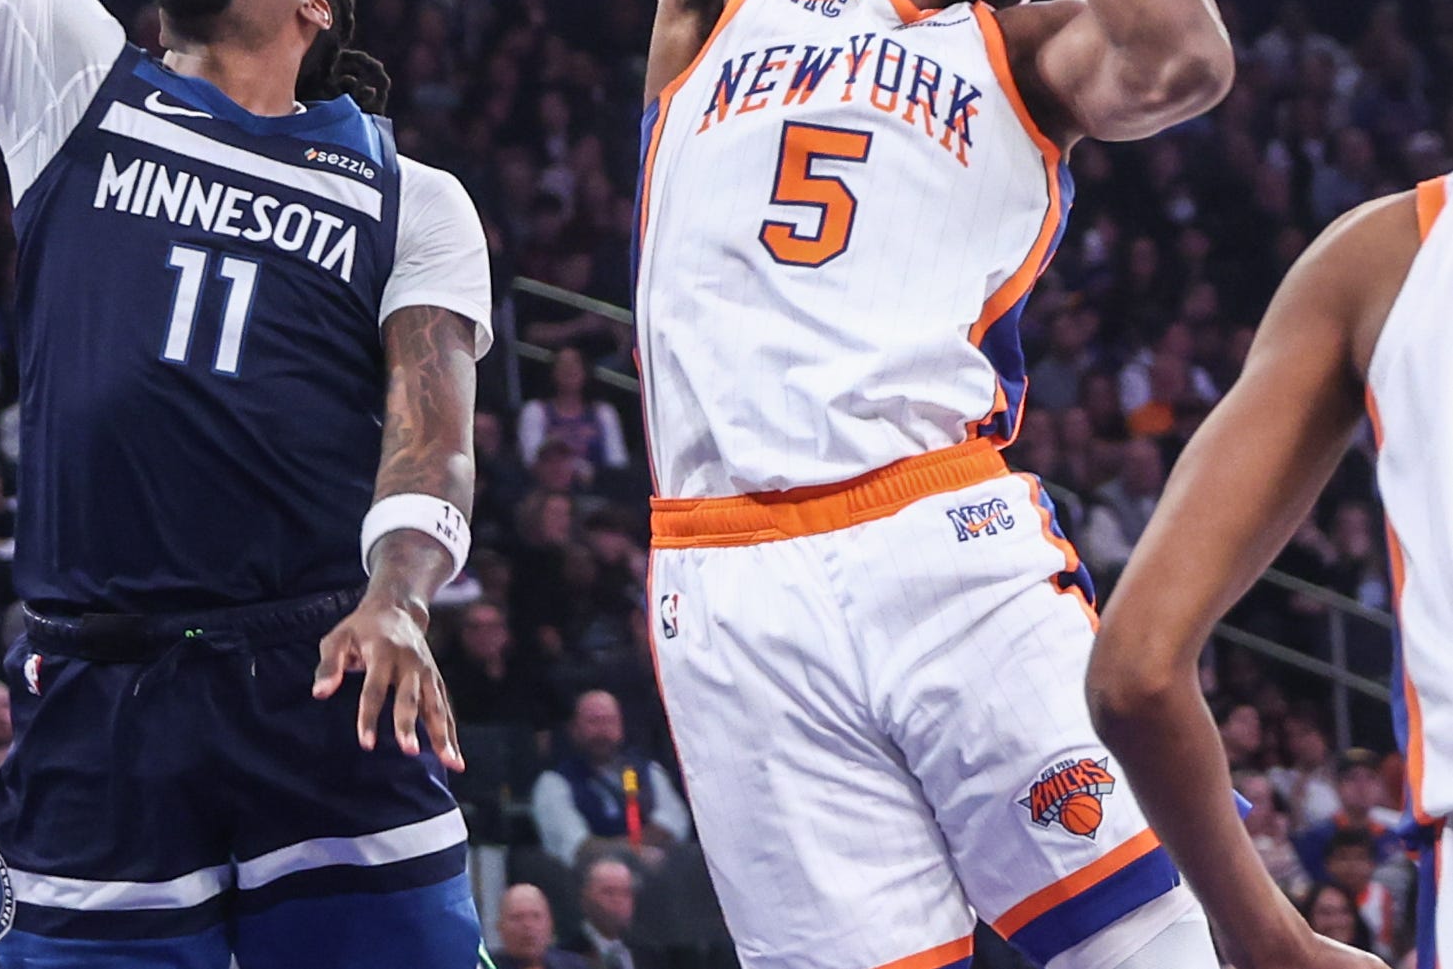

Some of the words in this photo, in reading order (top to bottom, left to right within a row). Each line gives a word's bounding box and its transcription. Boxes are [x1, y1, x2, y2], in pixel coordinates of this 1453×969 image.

[316, 151, 375, 180] sezzle
[758, 119, 873, 268] 5
[93, 151, 357, 283] MINNESOTA
[159, 241, 260, 378] 11
[442, 505, 461, 531] 11
[1030, 758, 1116, 824] KNICKS
